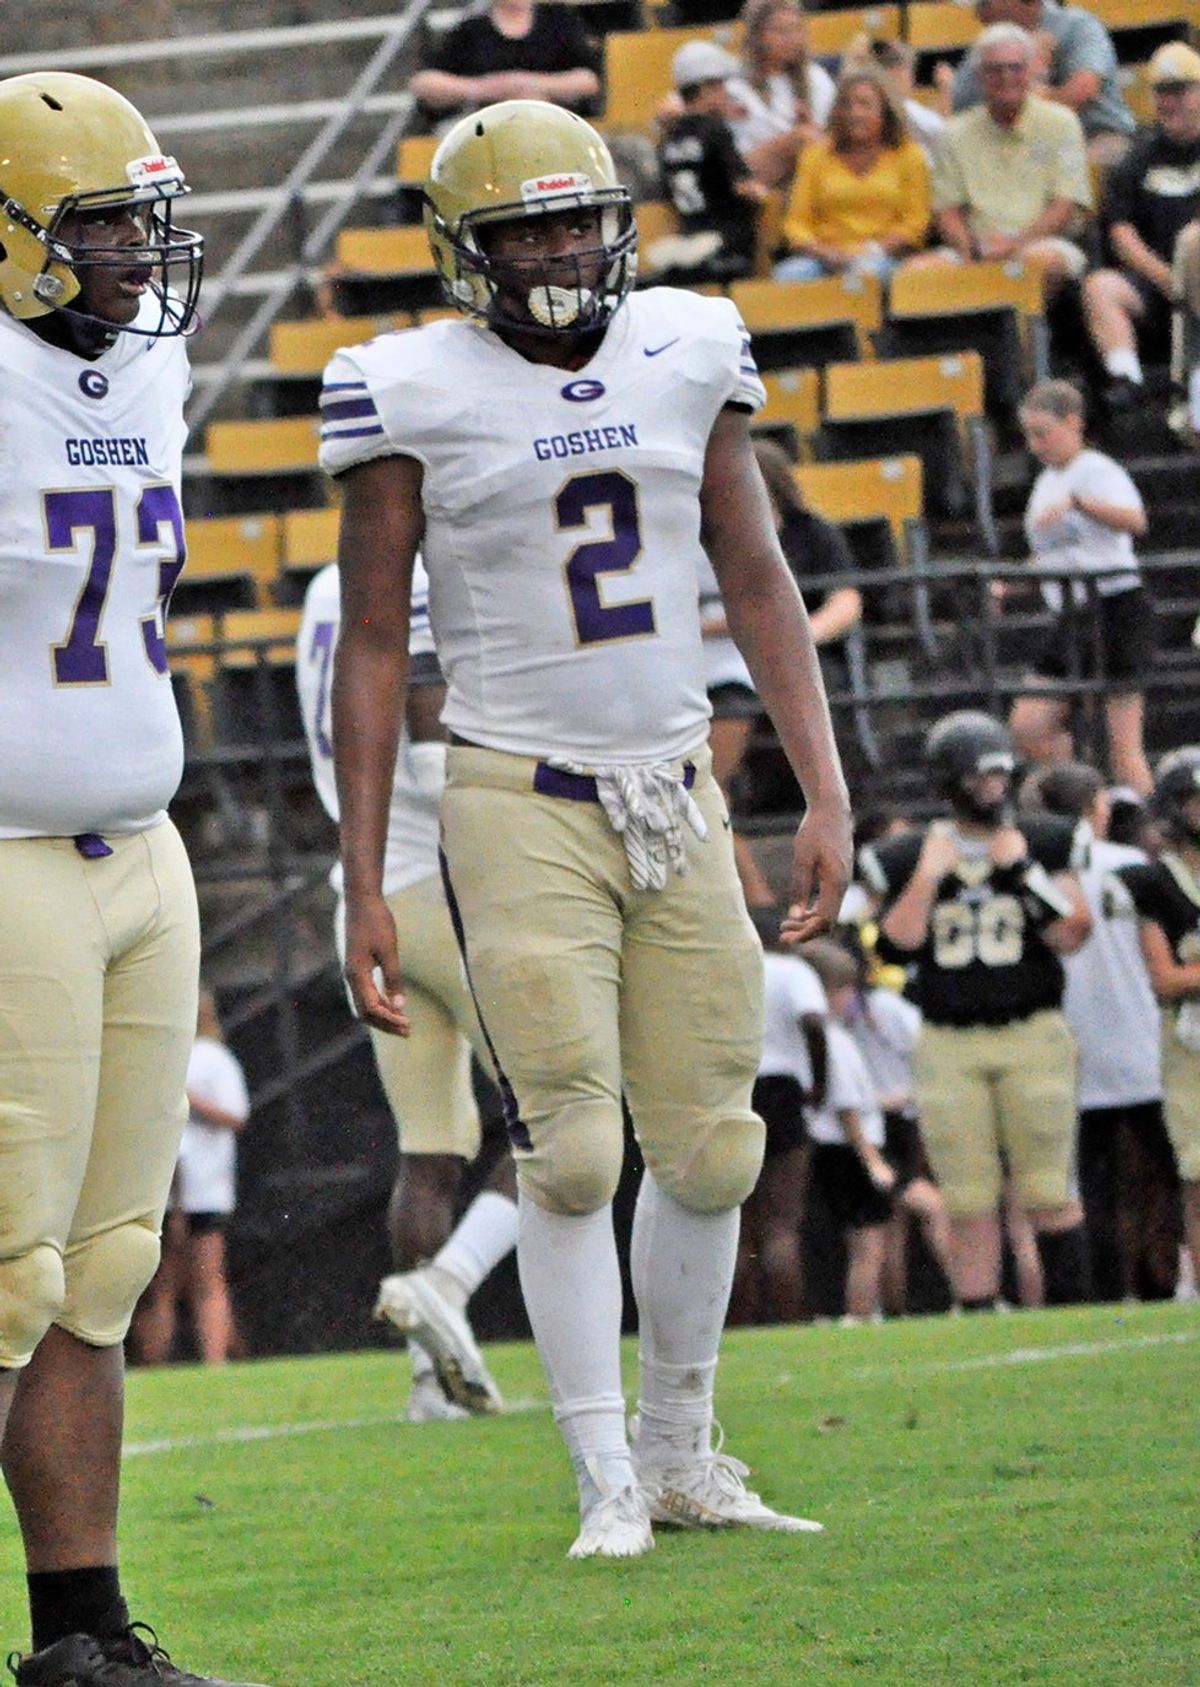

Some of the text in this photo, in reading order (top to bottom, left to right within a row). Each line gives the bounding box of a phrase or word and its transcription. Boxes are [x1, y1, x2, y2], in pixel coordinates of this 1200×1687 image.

[536, 176, 577, 192] Riddell
[79, 369, 109, 400] G
[561, 379, 606, 402] G
[65, 438, 149, 466] GOSHEN
[534, 424, 639, 461] GOSHEN
[551, 466, 659, 648] 2
[39, 480, 188, 688] 73
